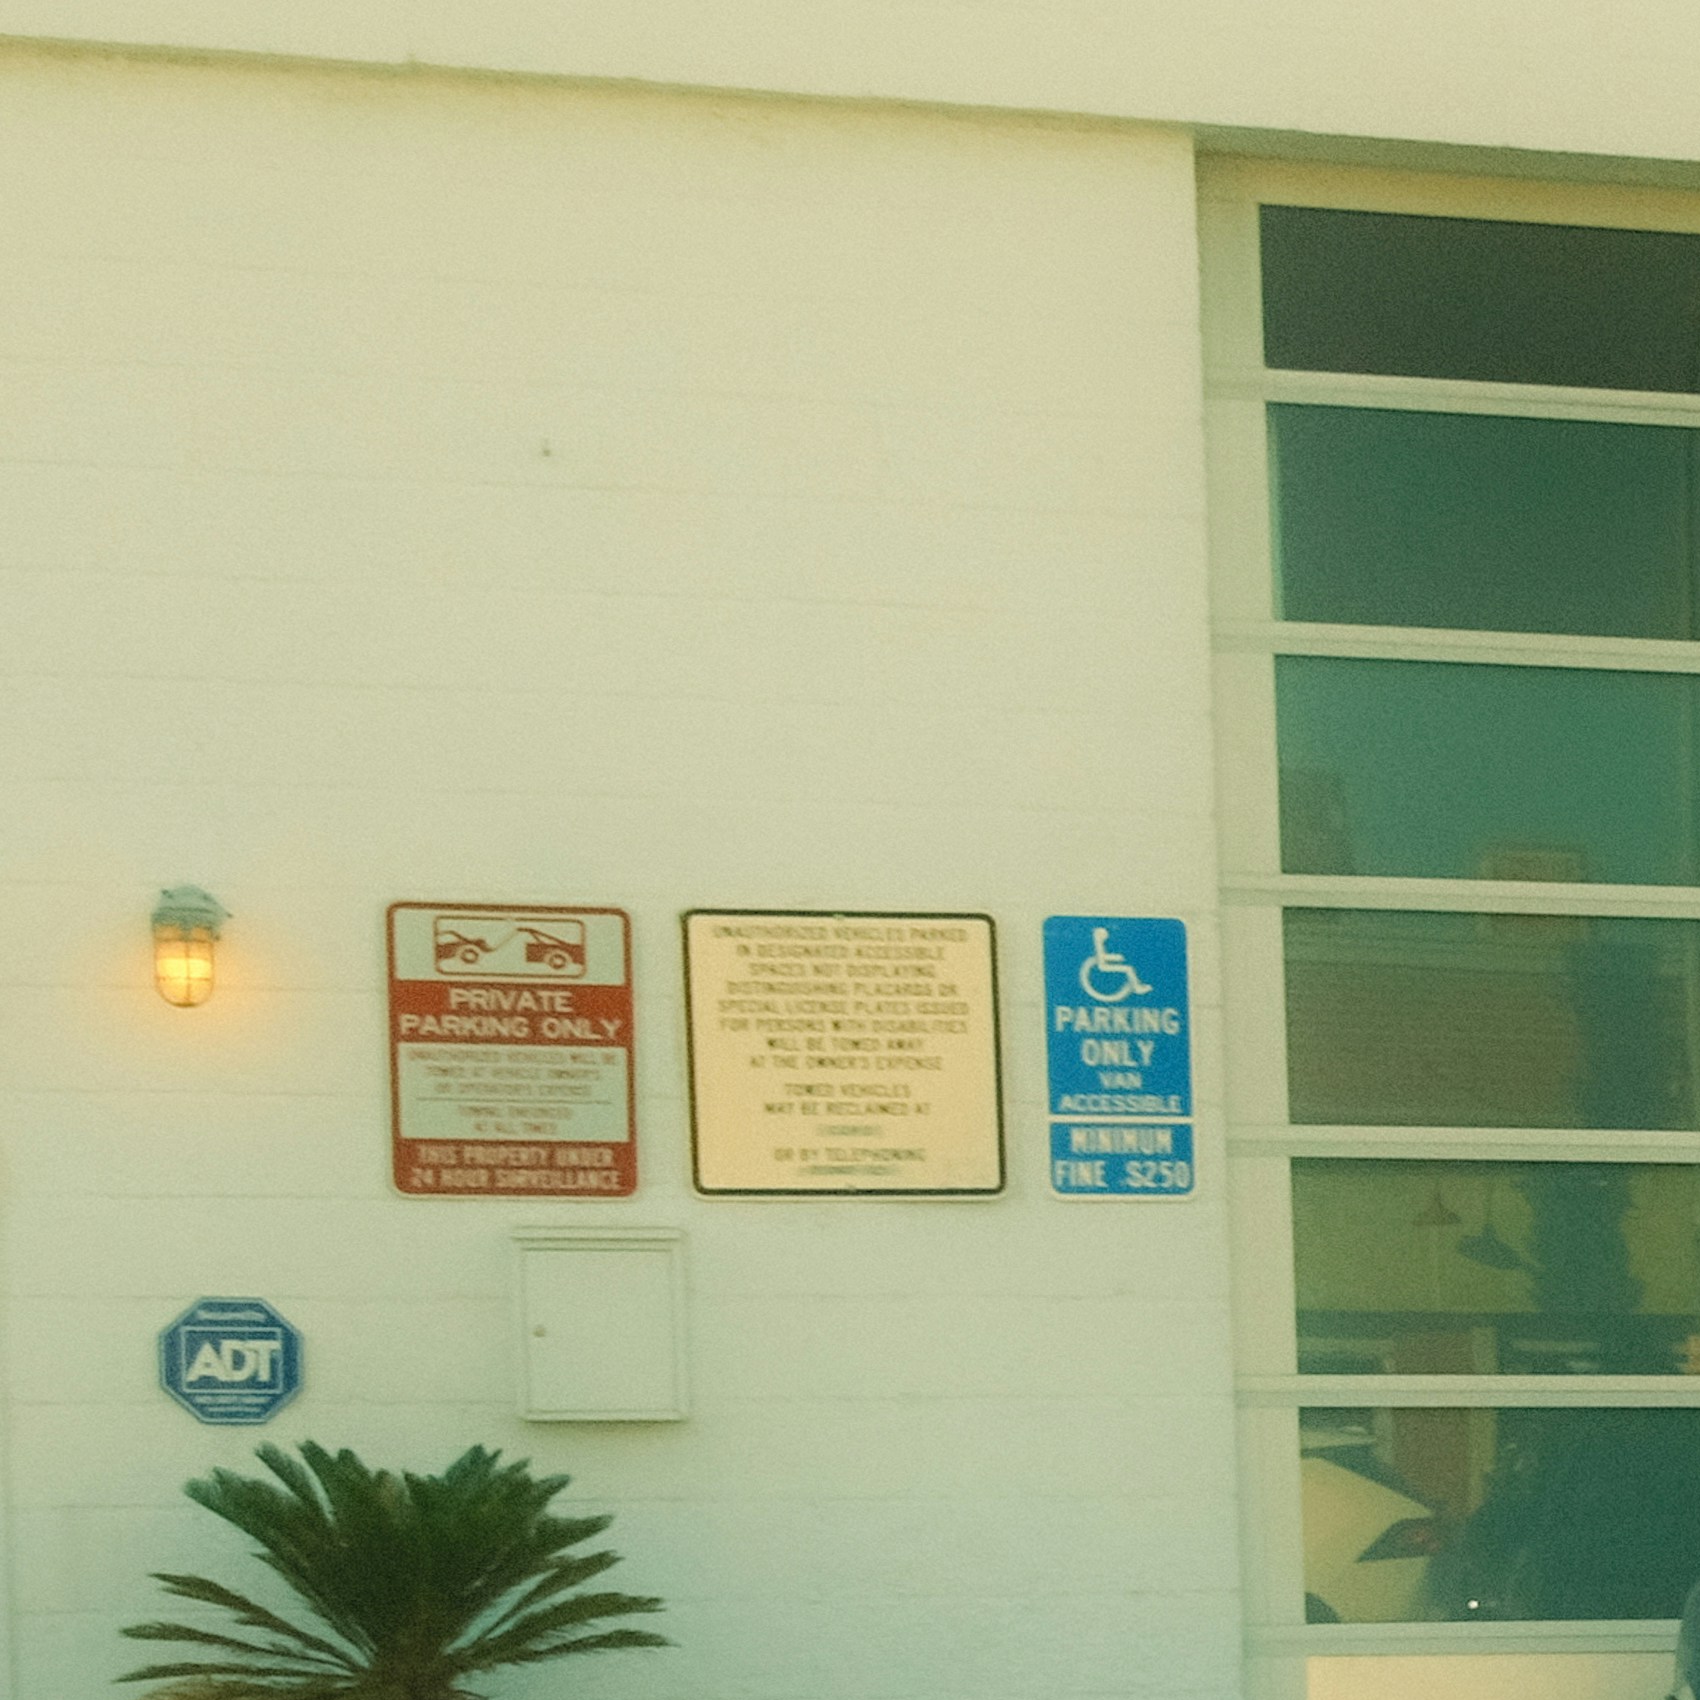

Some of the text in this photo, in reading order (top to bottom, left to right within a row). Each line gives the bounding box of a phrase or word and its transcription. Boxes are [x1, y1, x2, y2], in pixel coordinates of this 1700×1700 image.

[450, 988, 574, 1013] PRIVATE
[400, 1013, 622, 1040] PARKING ONLY
[1055, 1006, 1181, 1035] PARKING
[1081, 1038, 1155, 1067] ONLY
[1098, 1070, 1143, 1089] VAN
[1059, 1094, 1182, 1114] ACCESSIBLE
[1071, 1127, 1172, 1155] MINIMUM
[1054, 1160, 1108, 1188] FINE
[186, 1339, 282, 1382] ADT
